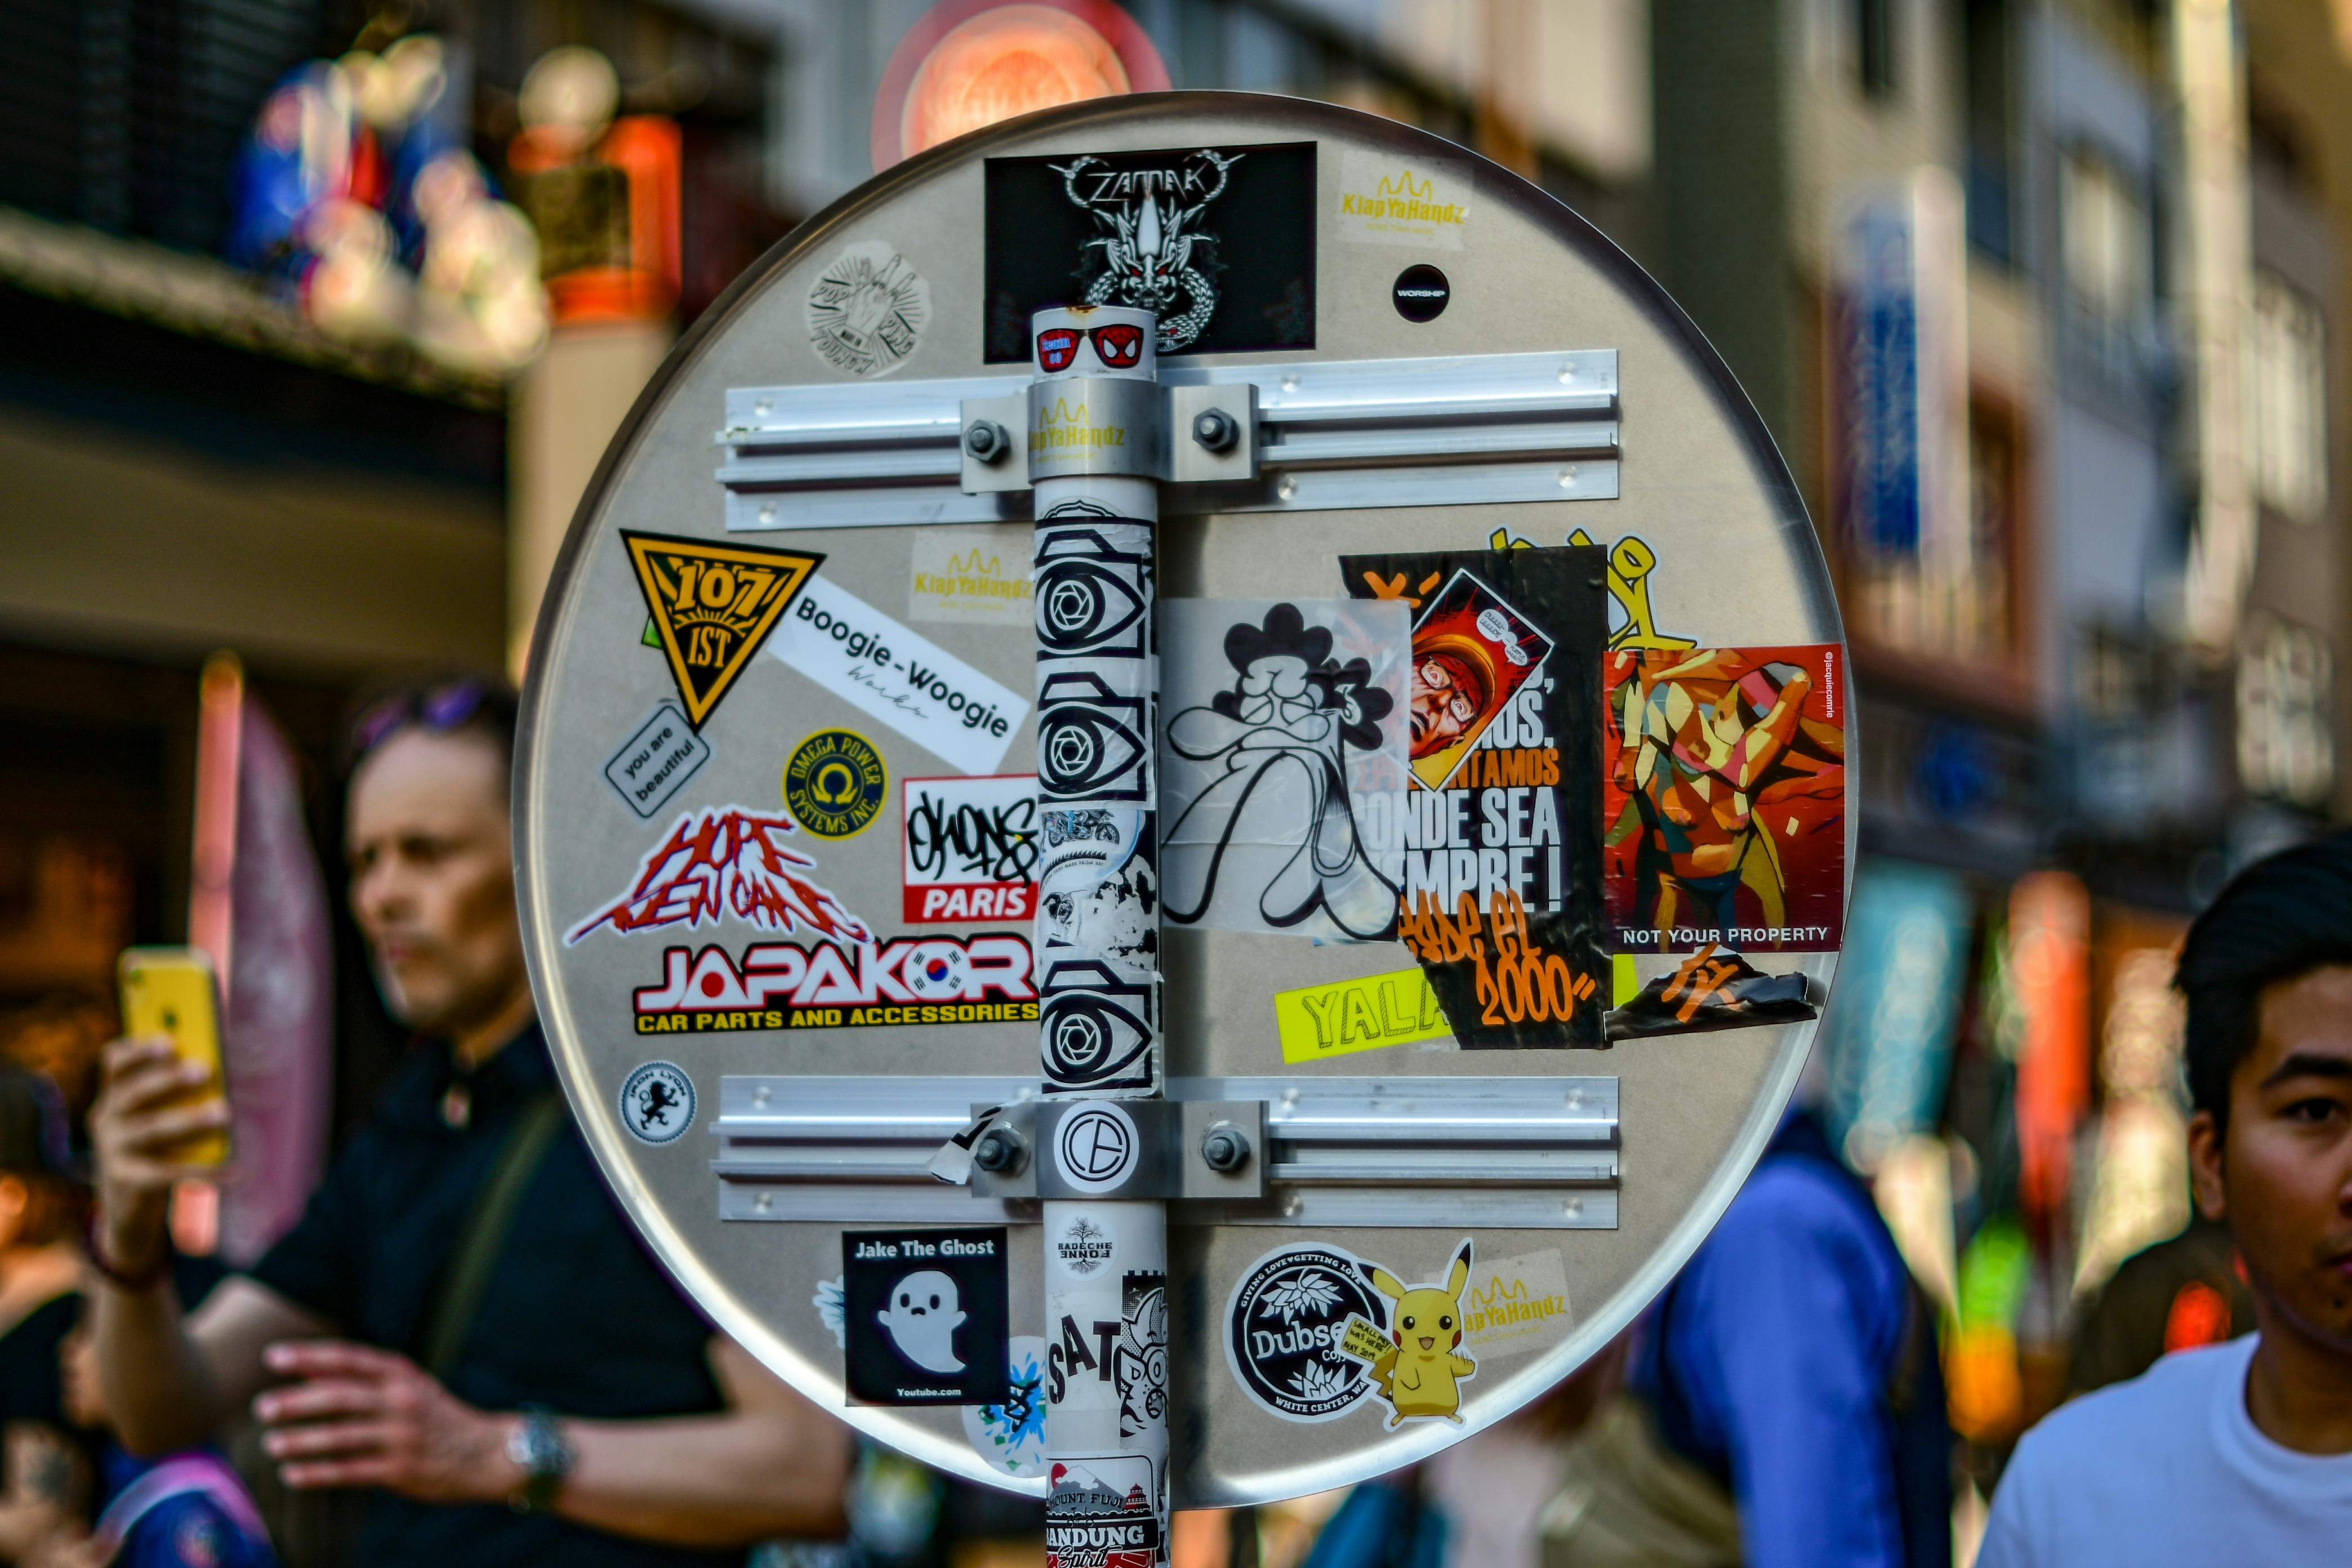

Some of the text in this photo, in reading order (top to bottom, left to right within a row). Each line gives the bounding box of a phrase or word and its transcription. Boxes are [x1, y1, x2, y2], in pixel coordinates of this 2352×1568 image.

[1342, 193, 1464, 225] KlapYaHandz
[1042, 338, 1071, 350] team
[1049, 352, 1062, 364] 03
[673, 564, 776, 617] 107
[914, 573, 1033, 602] KlapYaHandz
[687, 626, 732, 669] IST
[1824, 652, 1834, 718] @jacquiecomrie
[625, 727, 673, 779] you are
[791, 736, 881, 785] OMEGA POWER
[635, 738, 696, 801] beautiful
[790, 789, 879, 832] SYSTEMS INC.
[1481, 786, 1561, 847] SEA
[922, 887, 1027, 919] PARIS
[1623, 927, 1828, 943] NOT YOUR PROPERTY
[637, 937, 1036, 1010] JAPAKOR
[638, 1003, 1039, 1032] CAR PARTS AND ACCESSORIES
[630, 1070, 687, 1098] IRON LYON
[855, 1239, 995, 1258] Jake The Ghost
[1241, 1254, 1361, 1307] GIVING LOVE GETTING LOVE
[1353, 1320, 1376, 1338] SMALL
[1465, 1294, 1567, 1335] apYaHandz
[1253, 1320, 1342, 1359] Dubse
[1343, 1341, 1358, 1353] MAY
[1359, 1347, 1375, 1360] 2019
[1349, 1329, 1365, 1340] WAS
[897, 1388, 961, 1397] Youtube.com
[1276, 1396, 1308, 1413] WHITE
[1352, 1380, 1370, 1395] WA
[1090, 1493, 1124, 1508] FUJI
